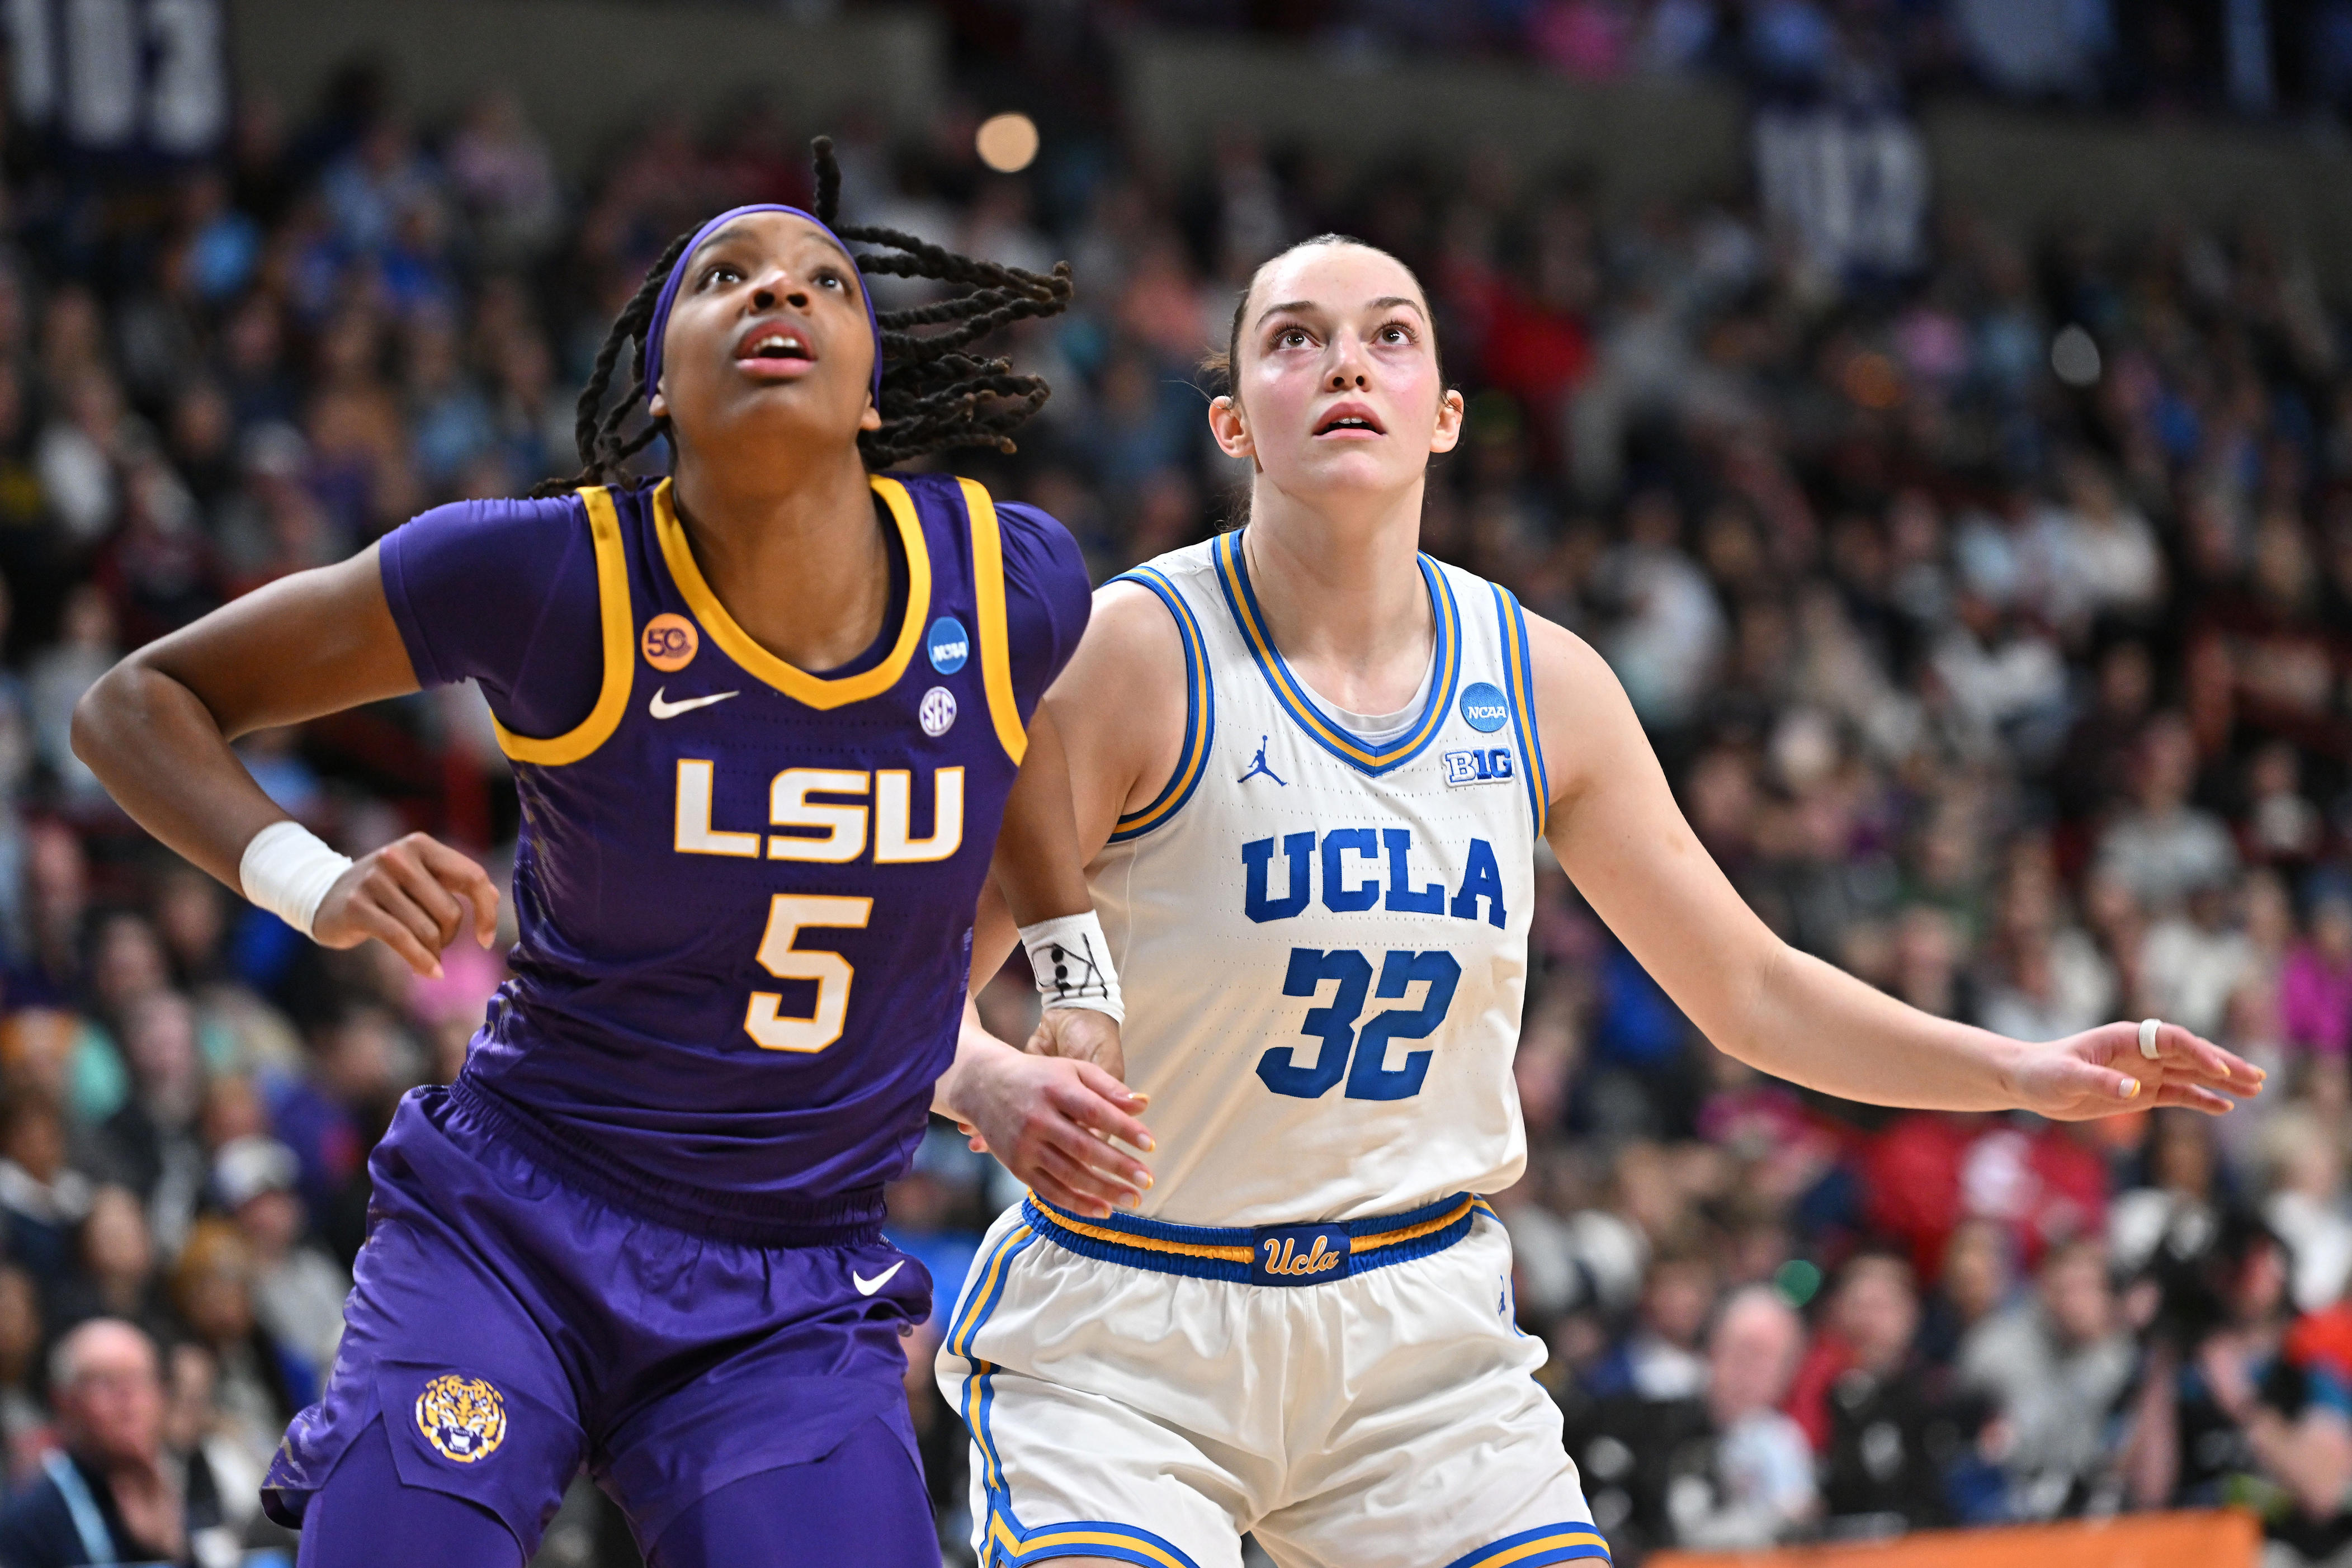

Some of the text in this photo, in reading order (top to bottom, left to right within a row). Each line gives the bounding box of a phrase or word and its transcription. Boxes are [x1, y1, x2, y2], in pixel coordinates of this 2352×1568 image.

[648, 629, 689, 658] 50
[932, 641, 967, 662] NCAA
[923, 692, 953, 732] SEC
[1467, 706, 1506, 719] NCAA
[674, 758, 965, 864] LSU
[1241, 828, 1506, 929] UCLA
[744, 893, 874, 1054] 5
[1255, 948, 1462, 1101] 32
[1264, 1235, 1340, 1276] Ucla
